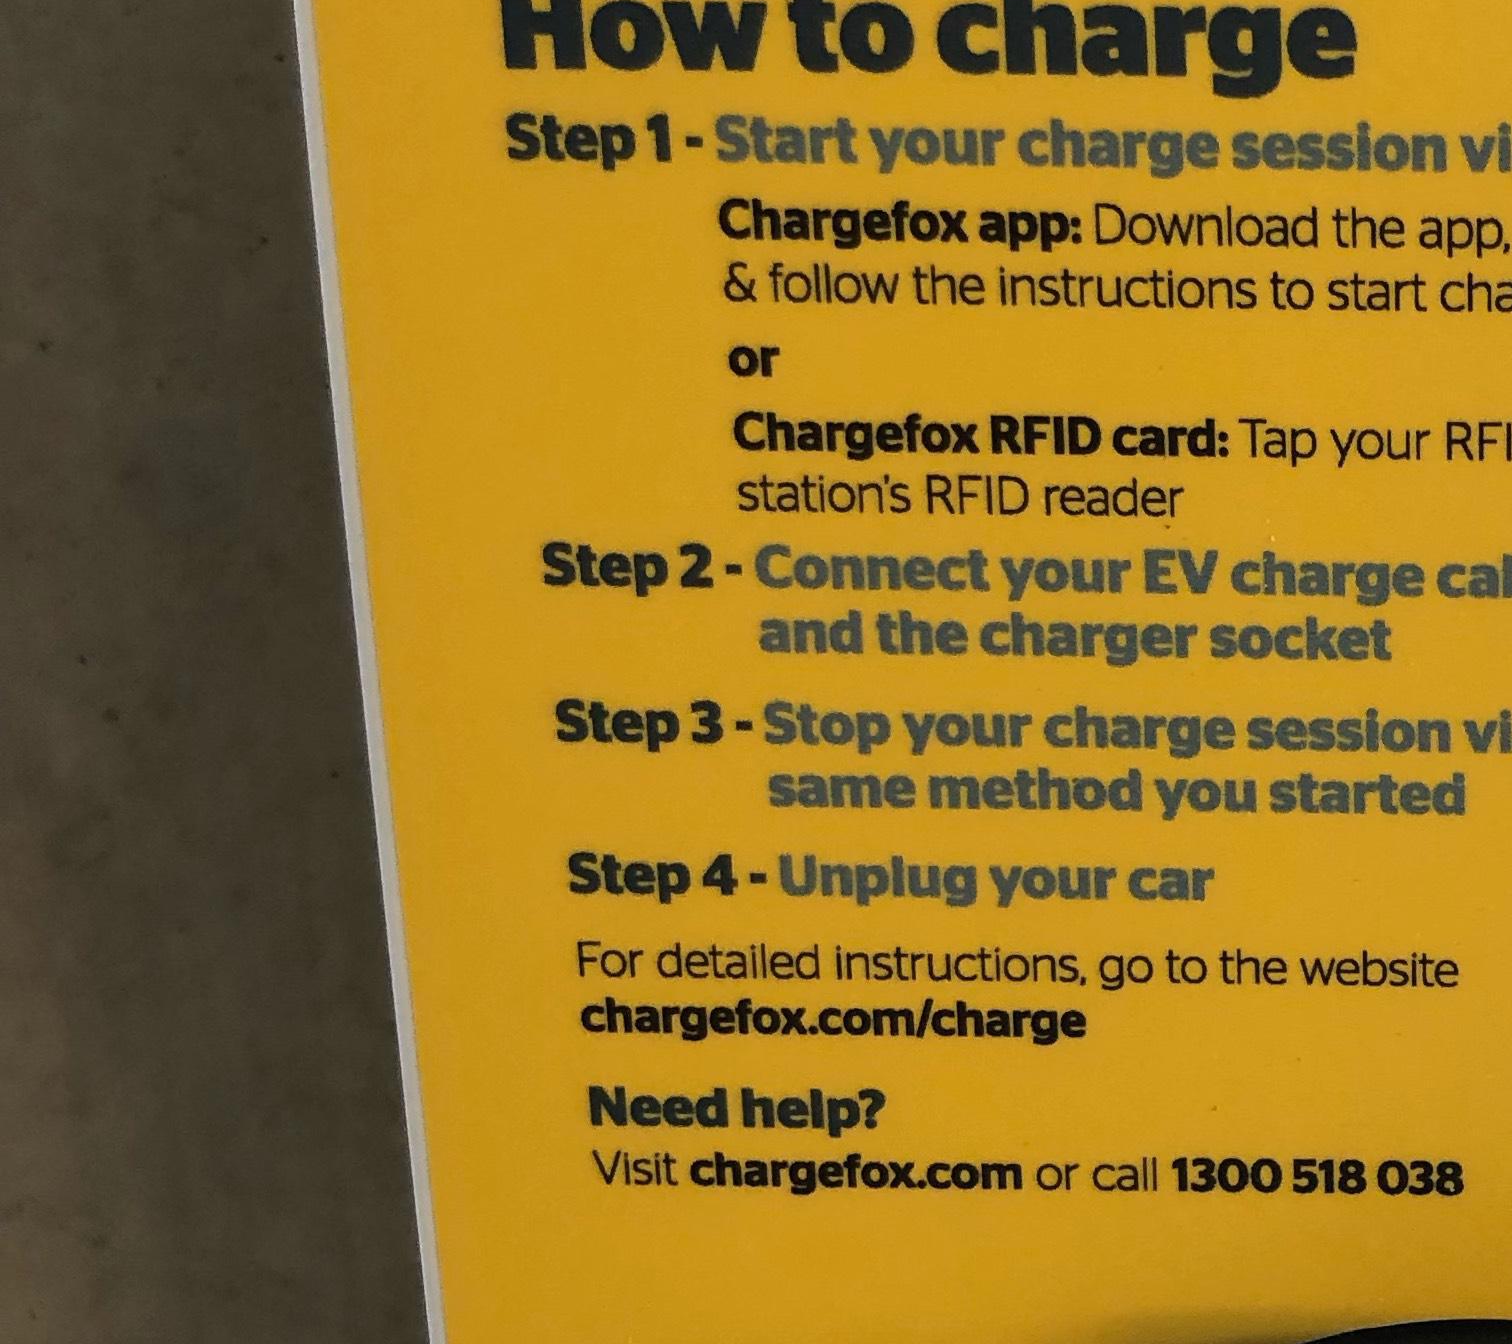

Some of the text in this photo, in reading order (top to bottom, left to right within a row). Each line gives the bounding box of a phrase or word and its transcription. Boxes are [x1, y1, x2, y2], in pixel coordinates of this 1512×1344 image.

[506, 112, 636, 171] Step
[646, 113, 672, 162] 1
[715, 114, 858, 164] Start
[868, 126, 1006, 174] your
[1017, 118, 1220, 179] charge
[1231, 120, 1448, 172] session
[717, 198, 968, 249] Chargefox
[979, 210, 1082, 252] app:
[1095, 203, 1318, 248] Download
[1332, 206, 1405, 249] the
[1419, 217, 1510, 258] app,
[724, 261, 757, 302] &
[768, 262, 899, 304] follow
[912, 264, 985, 305] the
[999, 266, 1257, 309] instructions
[1270, 271, 1314, 310] to
[1328, 273, 1427, 312] start
[728, 346, 780, 377] or
[733, 411, 980, 461] Chargefox
[990, 415, 1101, 455] RFID
[1112, 418, 1229, 457] card:
[1238, 418, 1317, 467] Tap
[1330, 429, 1430, 468] your
[738, 474, 1184, 517] station's RFID reader
[543, 541, 668, 597] Step
[680, 542, 713, 588] 2
[754, 544, 990, 592] Connect
[1000, 556, 1132, 601] your
[1144, 548, 1219, 594] EV
[1231, 550, 1425, 607] charge
[759, 609, 1392, 668] and the charger socket
[555, 698, 680, 753] Step
[691, 700, 723, 744] 3
[763, 699, 891, 755] Stop
[902, 712, 1032, 756] your
[1043, 705, 1236, 759] charge
[1247, 708, 1451, 753] session
[768, 767, 1466, 821] same method you started
[568, 851, 691, 904] Step
[702, 854, 738, 896] 4
[779, 853, 977, 908] Unplug
[989, 865, 1117, 908] your
[1128, 867, 1215, 901] car
[577, 941, 1459, 991] For detailed instructions, go to the website
[581, 997, 1086, 1045] chargefox.com/charge
[589, 1085, 886, 1138] Need help?
[592, 1150, 1464, 1196] Visit chargefox.com or call 1300 518 038
